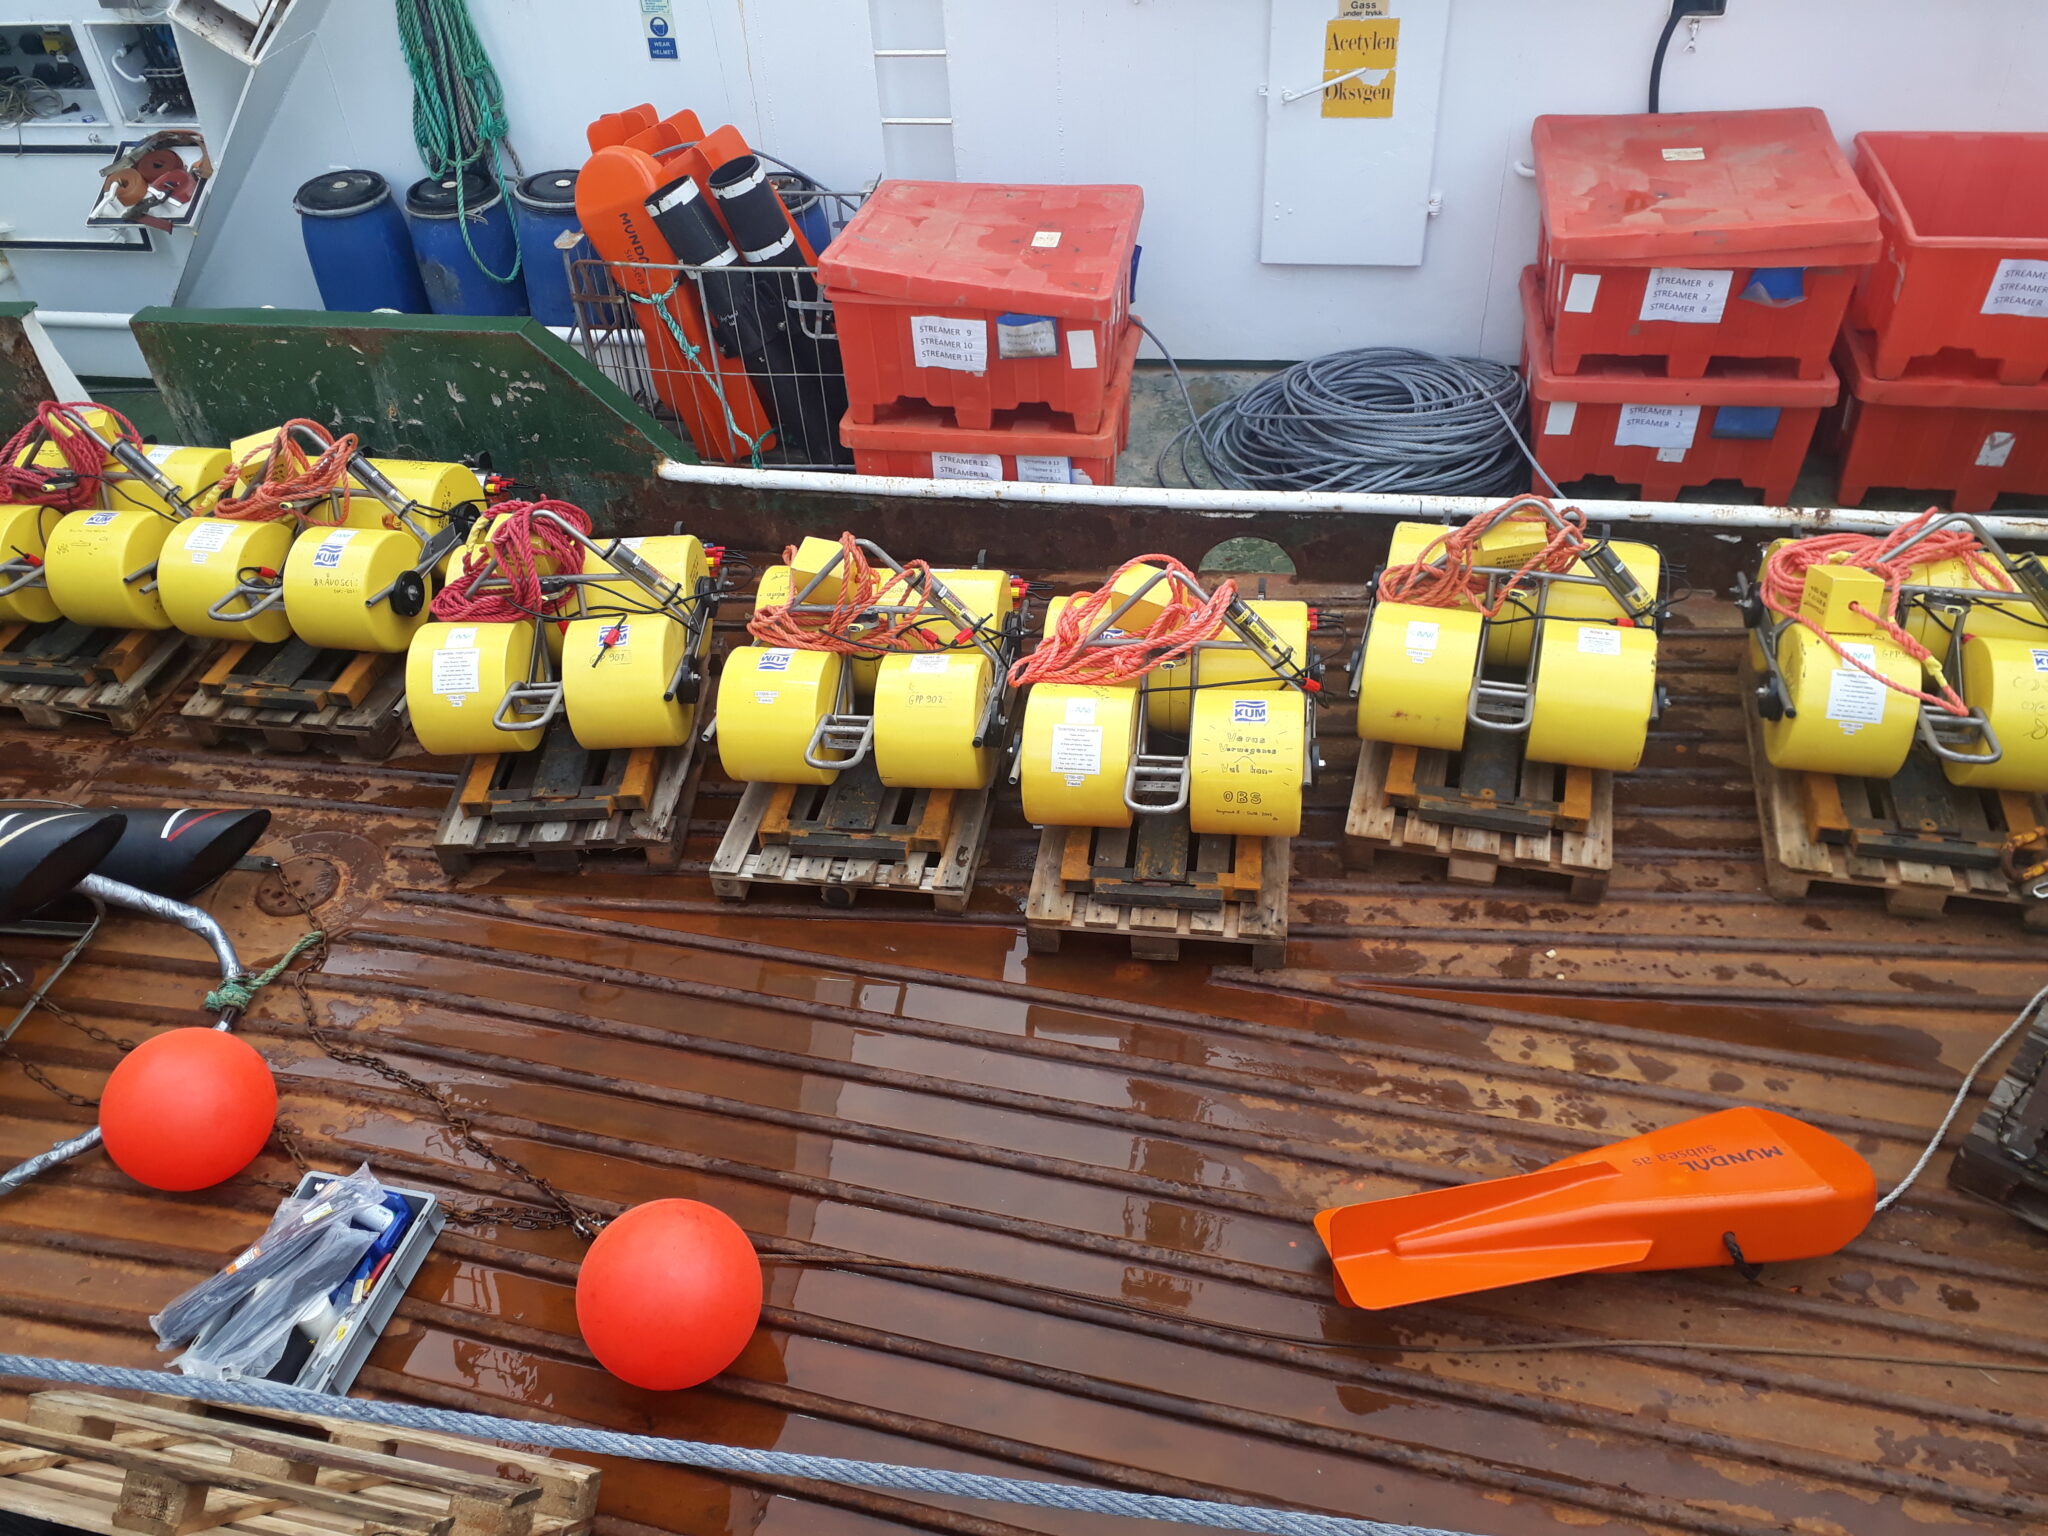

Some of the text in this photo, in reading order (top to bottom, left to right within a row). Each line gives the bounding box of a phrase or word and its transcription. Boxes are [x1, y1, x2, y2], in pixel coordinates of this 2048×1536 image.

[1350, 1, 1377, 9] Gass
[1327, 31, 1396, 56] Acetylen
[1325, 82, 1391, 104] Oksygen
[1656, 277, 1714, 288] STREAMER 6
[1653, 289, 1698, 300] STREAMER
[1993, 296, 2043, 307] STREAMER
[1649, 302, 1695, 313] STREAMER
[919, 325, 972, 337] STREAMER 9
[920, 338, 973, 350] STREAMER 10
[921, 350, 974, 362] STREAMER 11
[1629, 407, 1672, 416] STREAMER
[1626, 418, 1670, 427] STREAMER
[939, 455, 978, 466] STREAMER
[940, 466, 979, 477] STREAMER
[926, 695, 944, 704] 902
[1223, 790, 1262, 805] OBS
[1632, 1144, 1717, 1167] subsea as
[1678, 1145, 1785, 1172] MUNDAL
